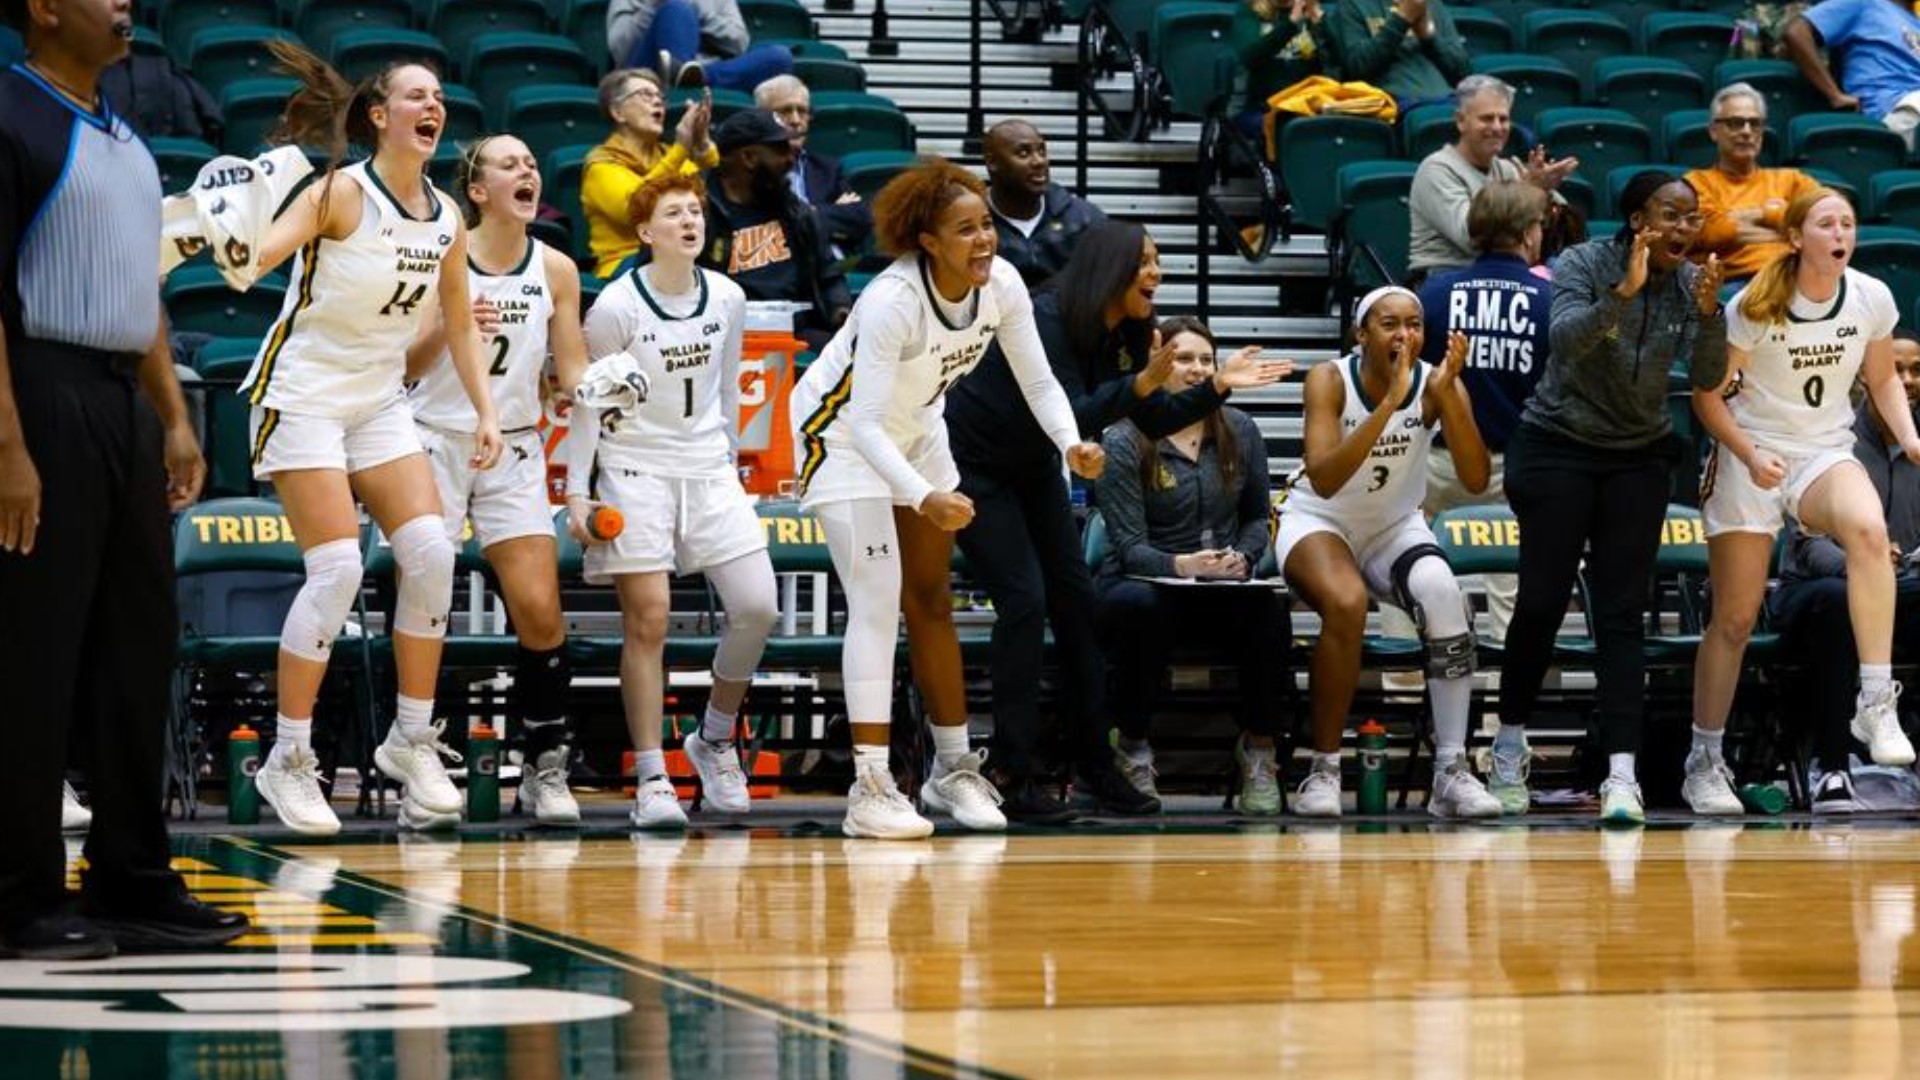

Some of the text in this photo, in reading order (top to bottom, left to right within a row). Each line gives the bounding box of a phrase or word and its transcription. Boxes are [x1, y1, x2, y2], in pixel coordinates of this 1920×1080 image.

[380, 281, 427, 315] 14
[498, 301, 530, 310] LIAM
[1449, 289, 1536, 335] R.M.C.
[502, 313, 528, 324] ARY
[490, 334, 510, 376] 2
[659, 342, 712, 357] WILLIAM
[1466, 335, 1534, 375] VENTS
[1787, 343, 1846, 357] WILLIAM
[683, 377, 693, 418] 1
[1803, 374, 1825, 408] 0
[1377, 434, 1411, 446] LIAM
[1367, 465, 1389, 493] 3
[1444, 519, 1520, 546] TRIB
